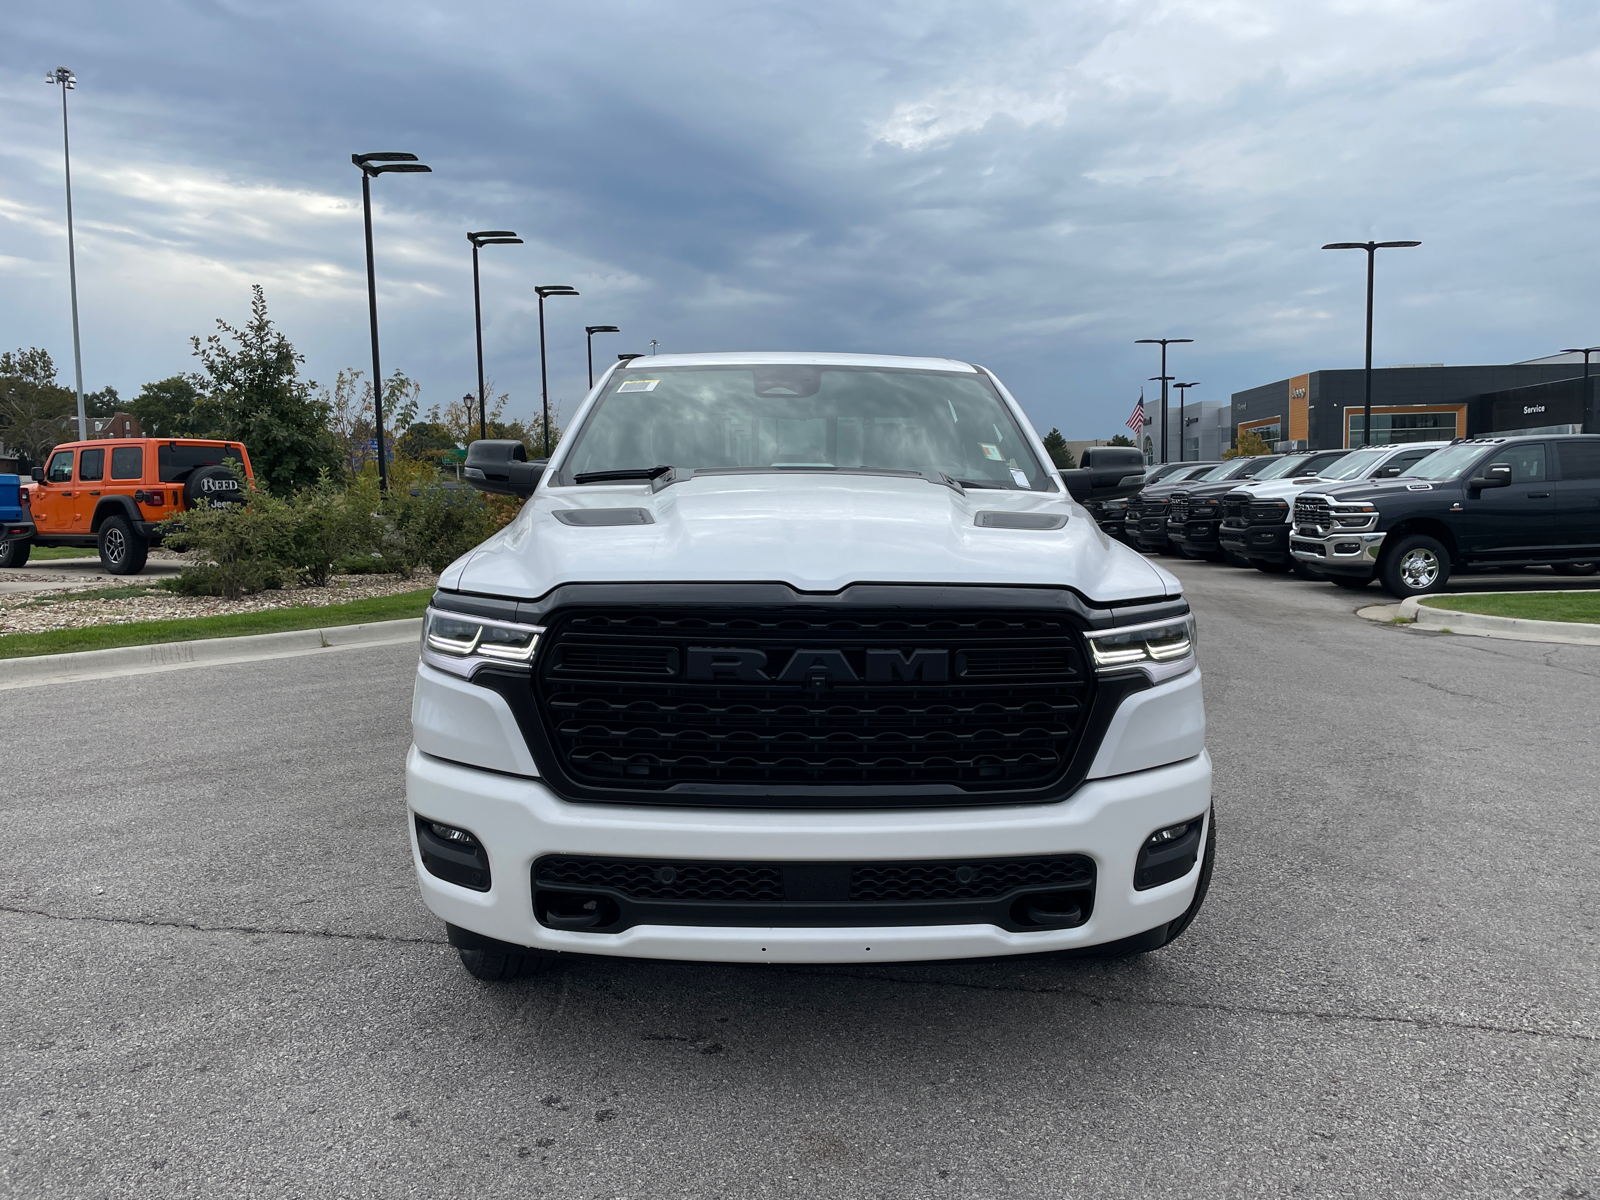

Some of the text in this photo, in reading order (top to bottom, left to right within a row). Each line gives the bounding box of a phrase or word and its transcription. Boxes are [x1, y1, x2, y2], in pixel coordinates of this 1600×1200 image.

[1292, 388, 1306, 399] Jeep
[1523, 404, 1545, 414] Service
[201, 477, 238, 493] REED
[687, 646, 949, 681] RAM
